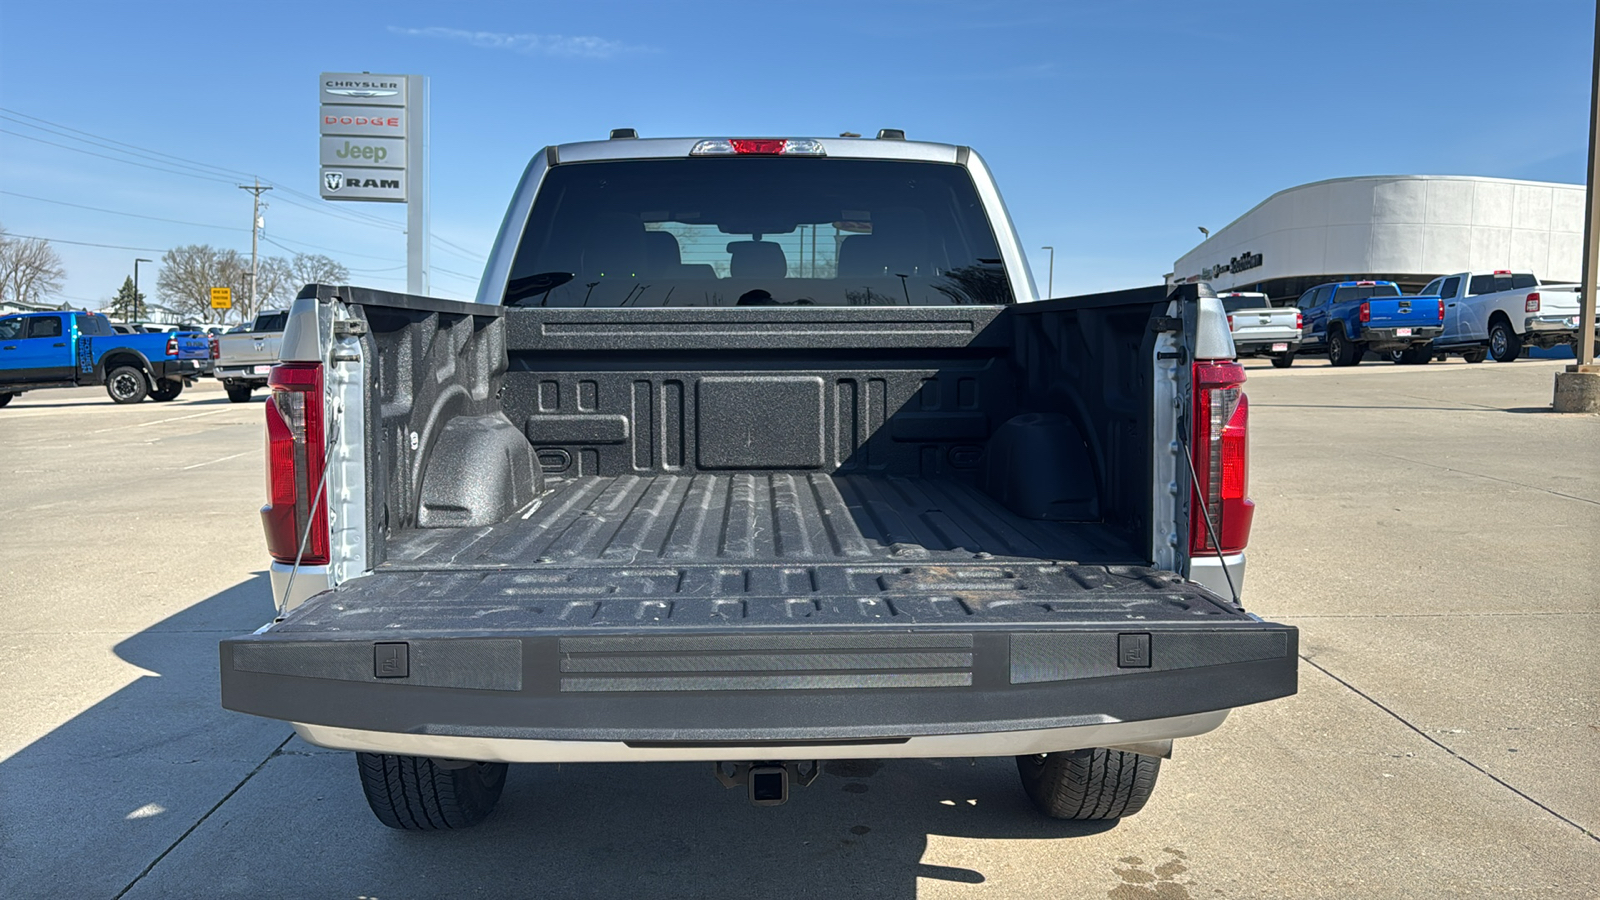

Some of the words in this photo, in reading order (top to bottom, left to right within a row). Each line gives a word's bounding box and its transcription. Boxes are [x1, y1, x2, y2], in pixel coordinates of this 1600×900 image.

[326, 81, 398, 89] CHRYSLER
[325, 116, 399, 127] DODGE
[336, 141, 387, 163] Jeep
[346, 178, 400, 189] RAM
